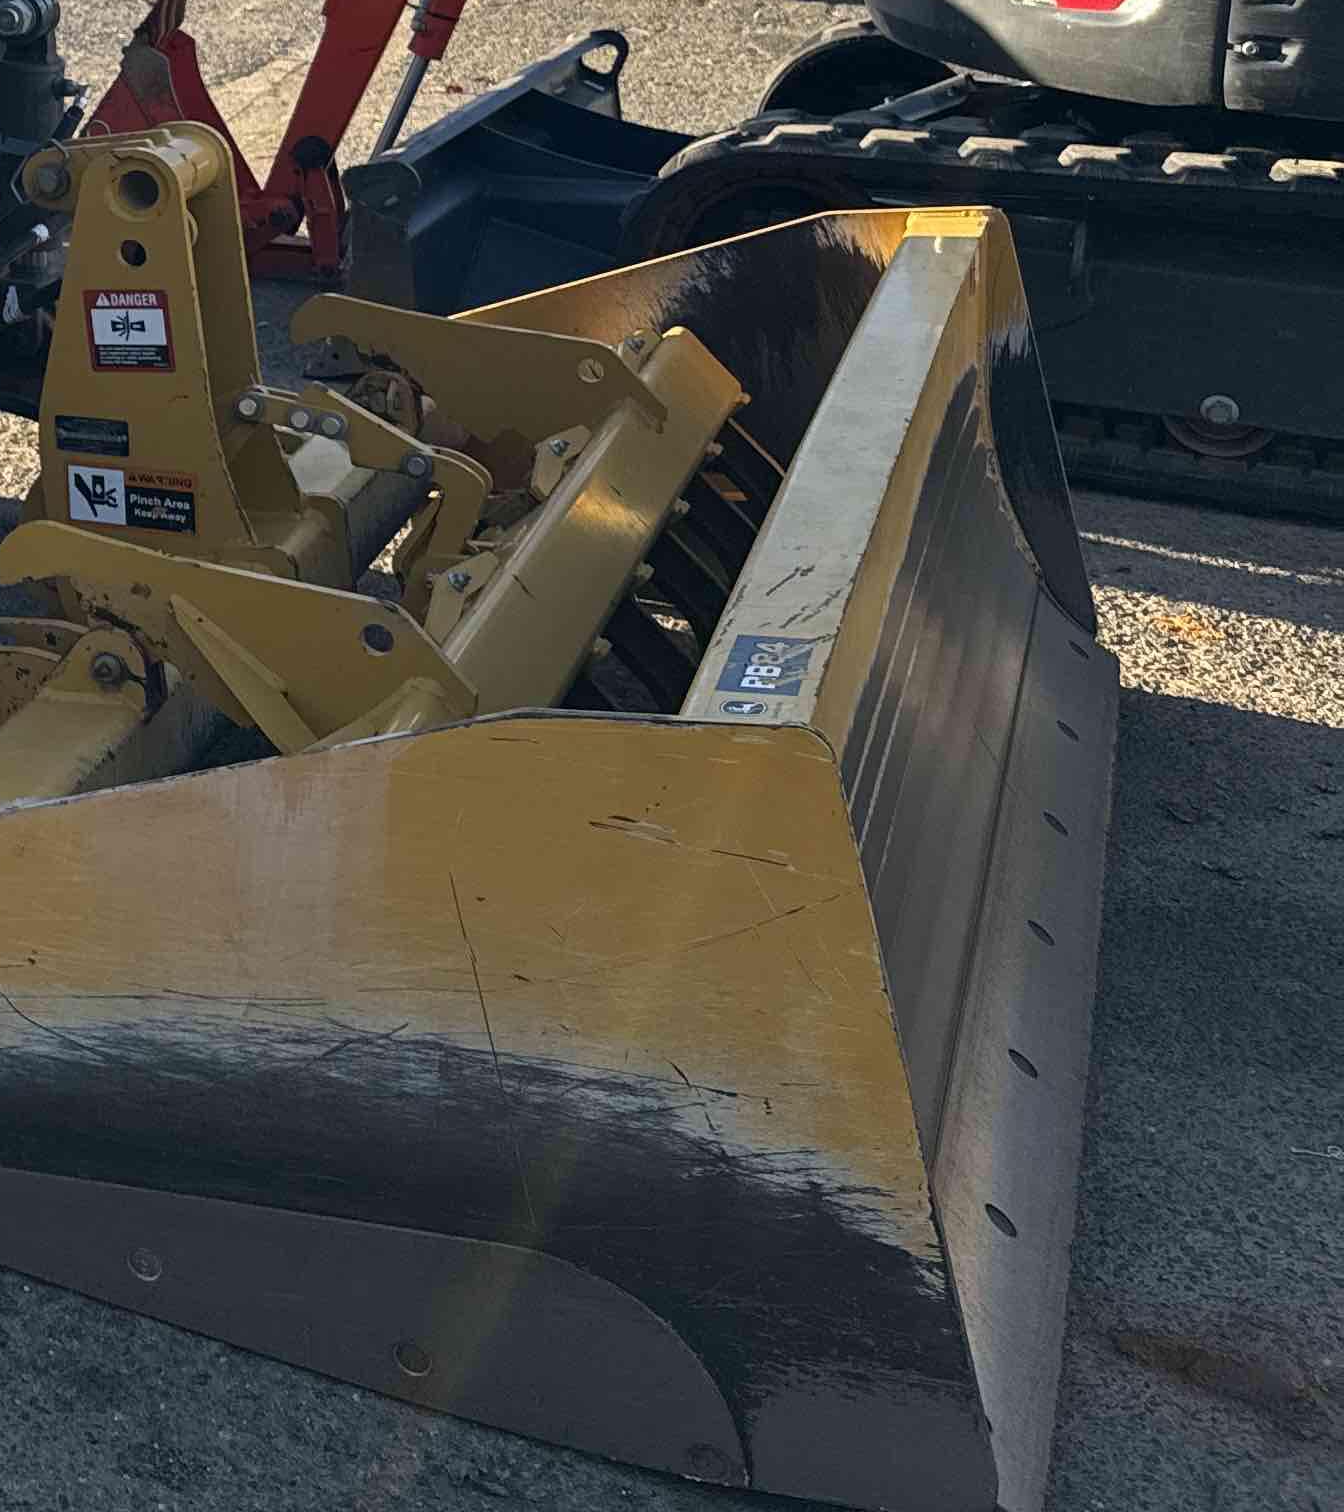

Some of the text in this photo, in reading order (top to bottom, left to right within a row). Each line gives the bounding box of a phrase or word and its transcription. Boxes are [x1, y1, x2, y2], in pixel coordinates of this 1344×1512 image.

[111, 292, 158, 307] DANGER
[129, 494, 191, 511] Pinch Area
[739, 641, 791, 690] PB84
